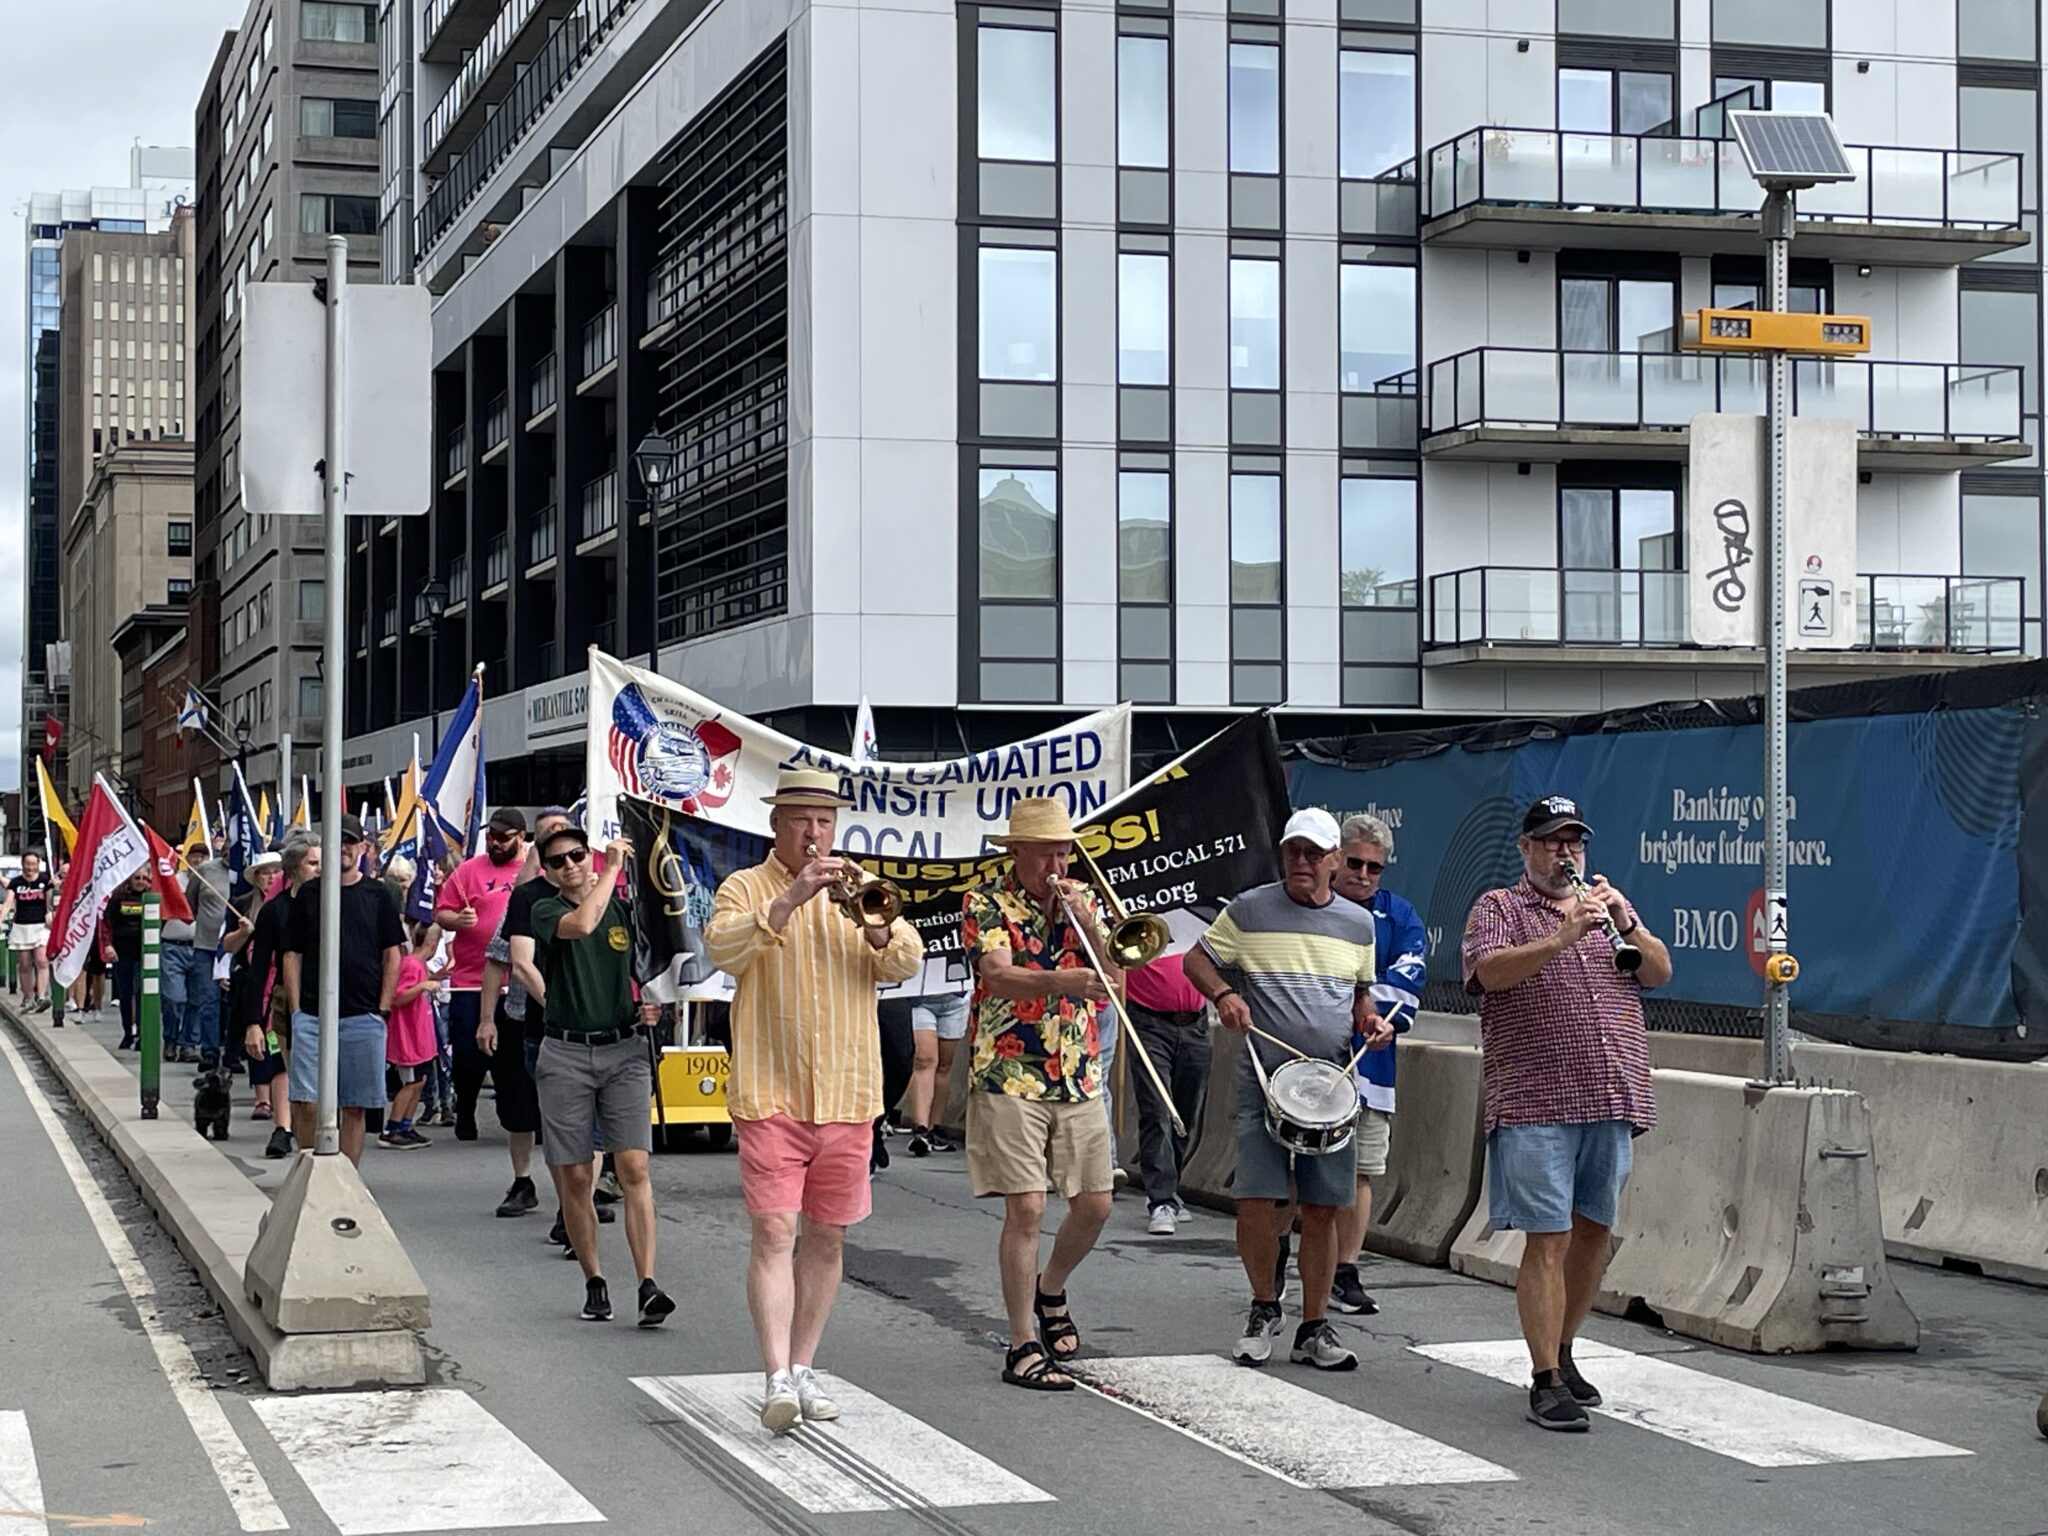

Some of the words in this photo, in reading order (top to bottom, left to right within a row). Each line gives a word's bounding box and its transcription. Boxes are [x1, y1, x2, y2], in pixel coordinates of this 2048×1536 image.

[165, 194, 195, 217] 18
[778, 730, 1102, 786] AMALGAMATED
[838, 778, 957, 818] ANSIT
[1673, 786, 1750, 832] Banking
[1752, 795, 1765, 821] o
[841, 824, 942, 859] OCAL
[1143, 844, 1212, 877] LOCAL
[1214, 834, 1247, 856] 571
[1640, 830, 1716, 875] brighter
[1718, 829, 1765, 865] futur
[858, 855, 1005, 883] MUSI
[907, 910, 965, 929] eration
[1673, 908, 1738, 951] BMO
[923, 928, 967, 953] .atl
[685, 1056, 731, 1076] 1908
